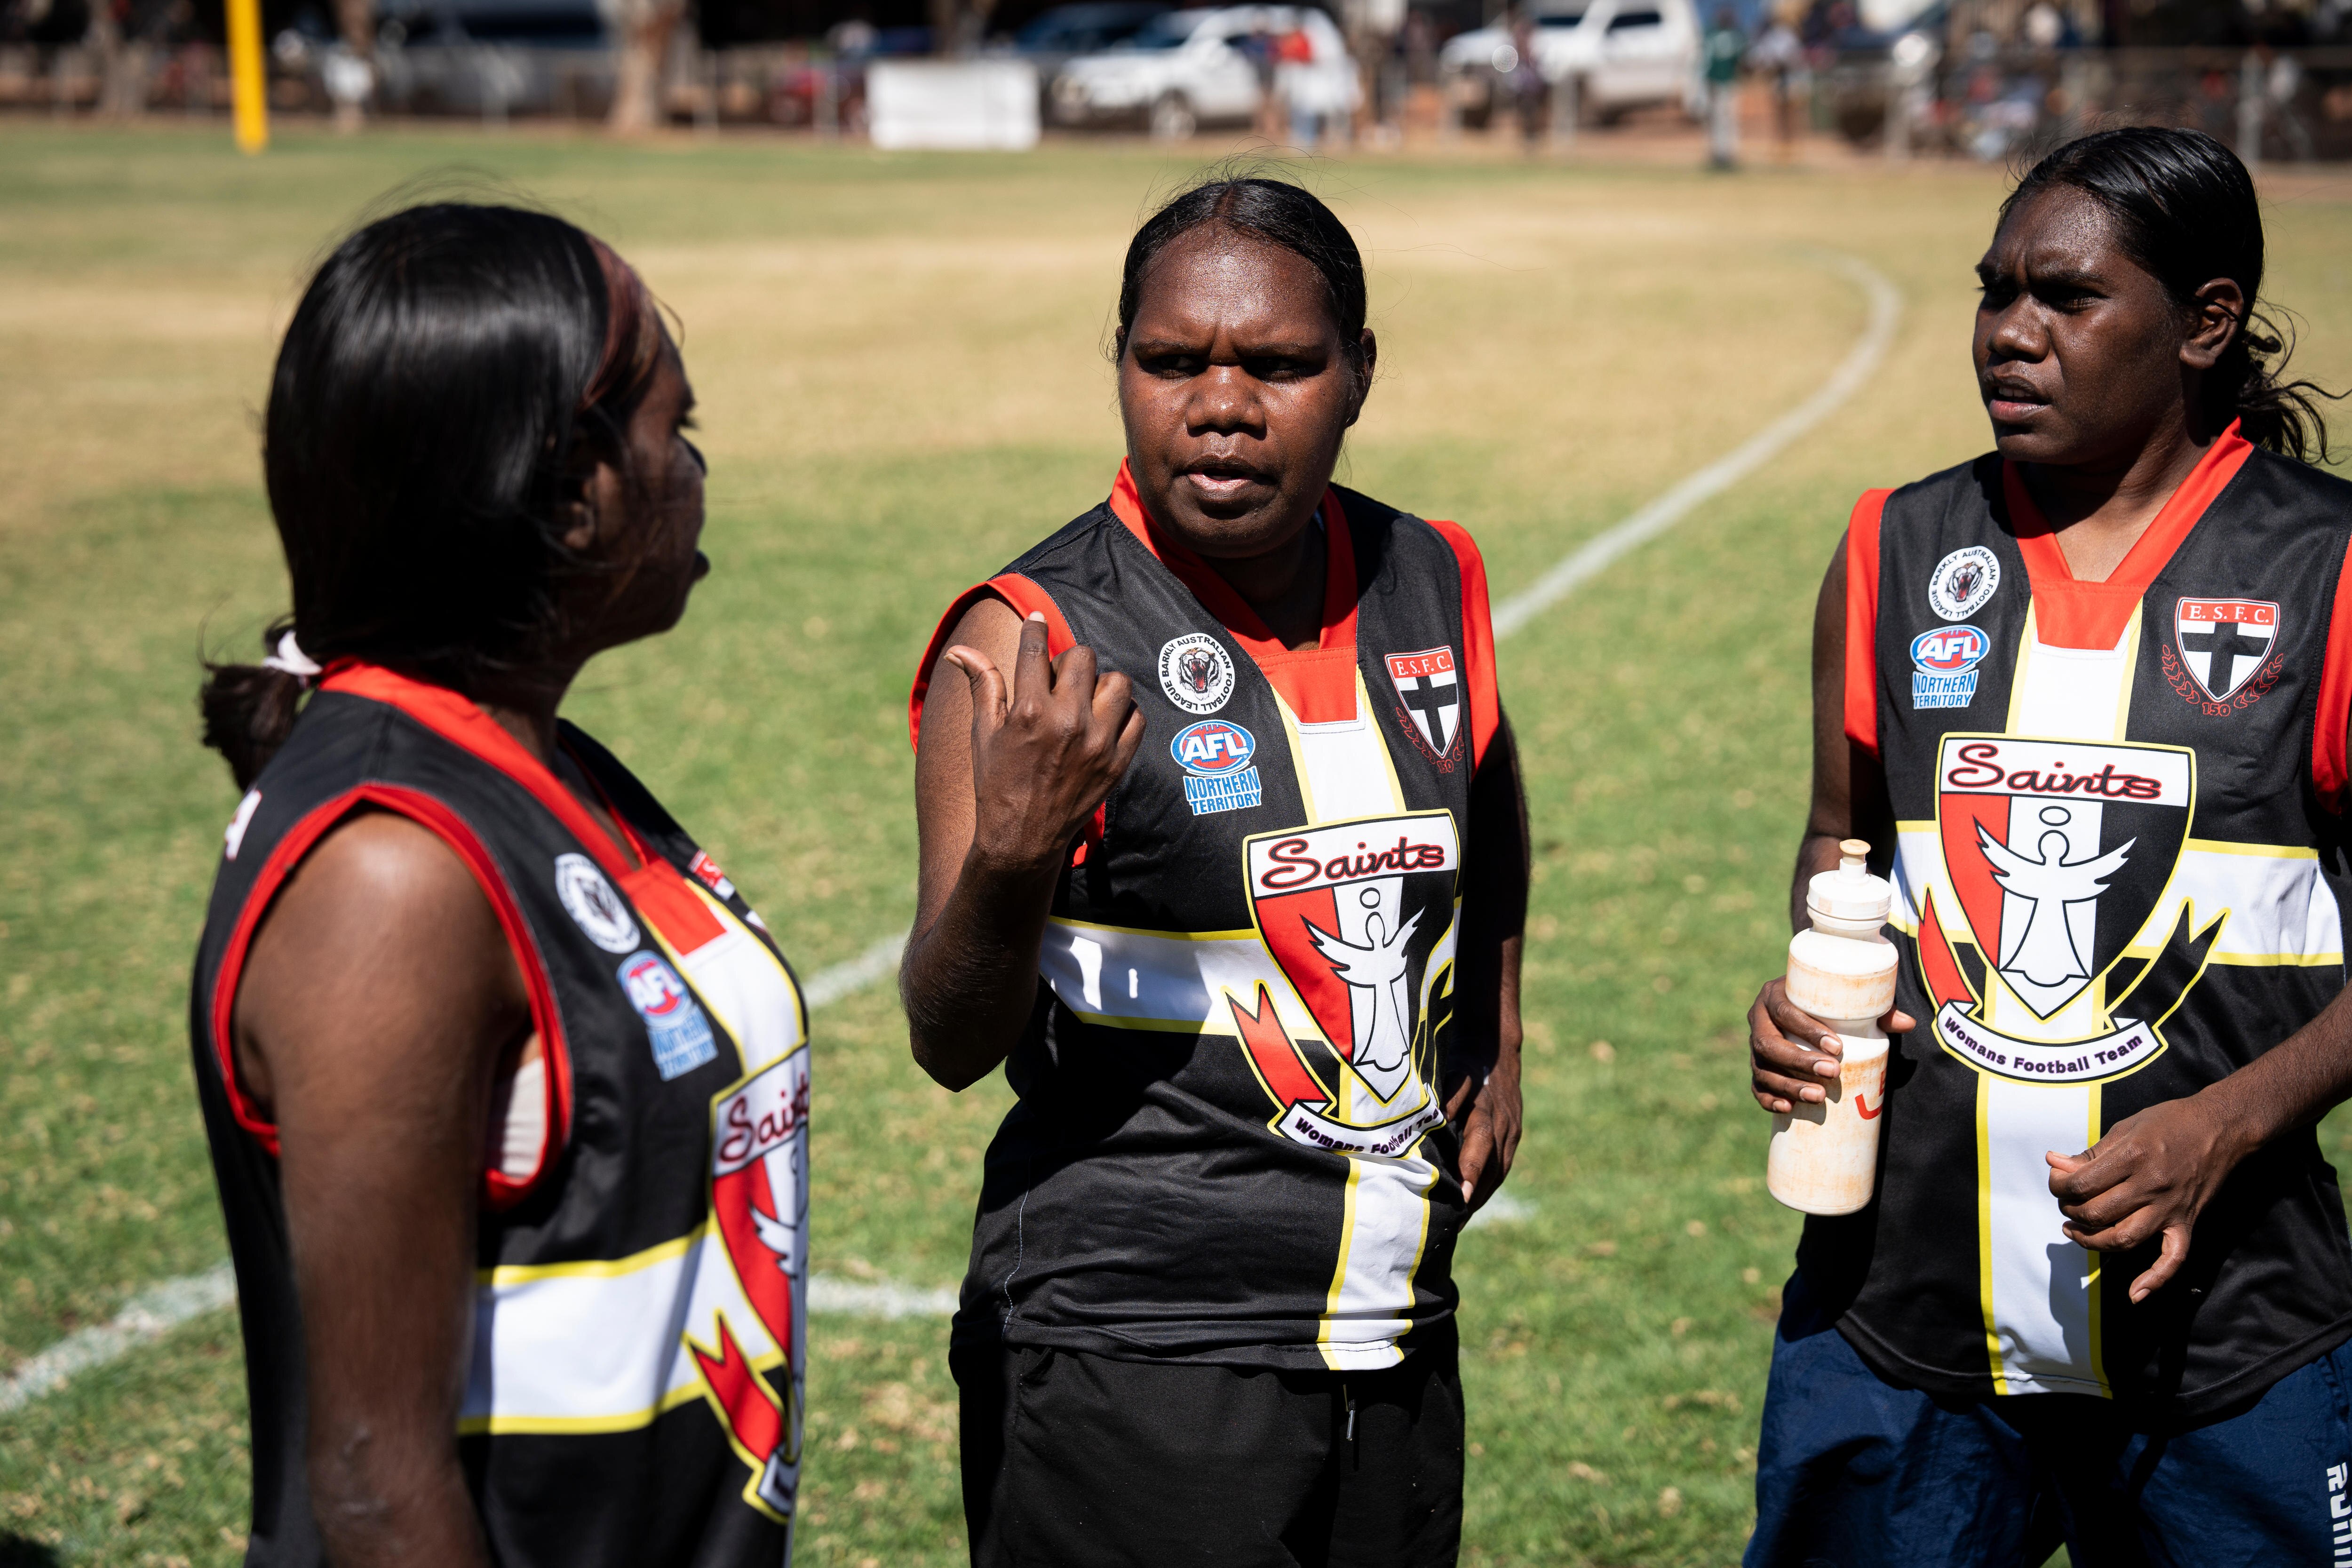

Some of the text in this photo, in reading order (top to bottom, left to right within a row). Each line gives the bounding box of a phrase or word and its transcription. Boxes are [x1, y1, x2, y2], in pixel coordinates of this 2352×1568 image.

[1931, 549, 1996, 618] BARKLY AUSTRALIAN FOOTBALL LEAGUE
[1916, 635, 1980, 661] AFL
[1162, 636, 1232, 711] BARKLY AUSTRALIAN FOOTBALL LEAGUE
[1914, 672, 1977, 694] NORTHERN
[1914, 694, 1972, 708] TERRITORY
[2202, 702, 2231, 717] 150
[1182, 732, 1250, 762] AFL
[1185, 769, 1261, 800] NORTHERN
[1948, 743, 2162, 800] Saints
[1191, 791, 1261, 814] TERRITORY
[1260, 836, 1445, 889] Saints
[1943, 1015, 2143, 1074] Womans Football Team
[718, 1072, 808, 1163] Saint
[1294, 1116, 1365, 1153] Womans
